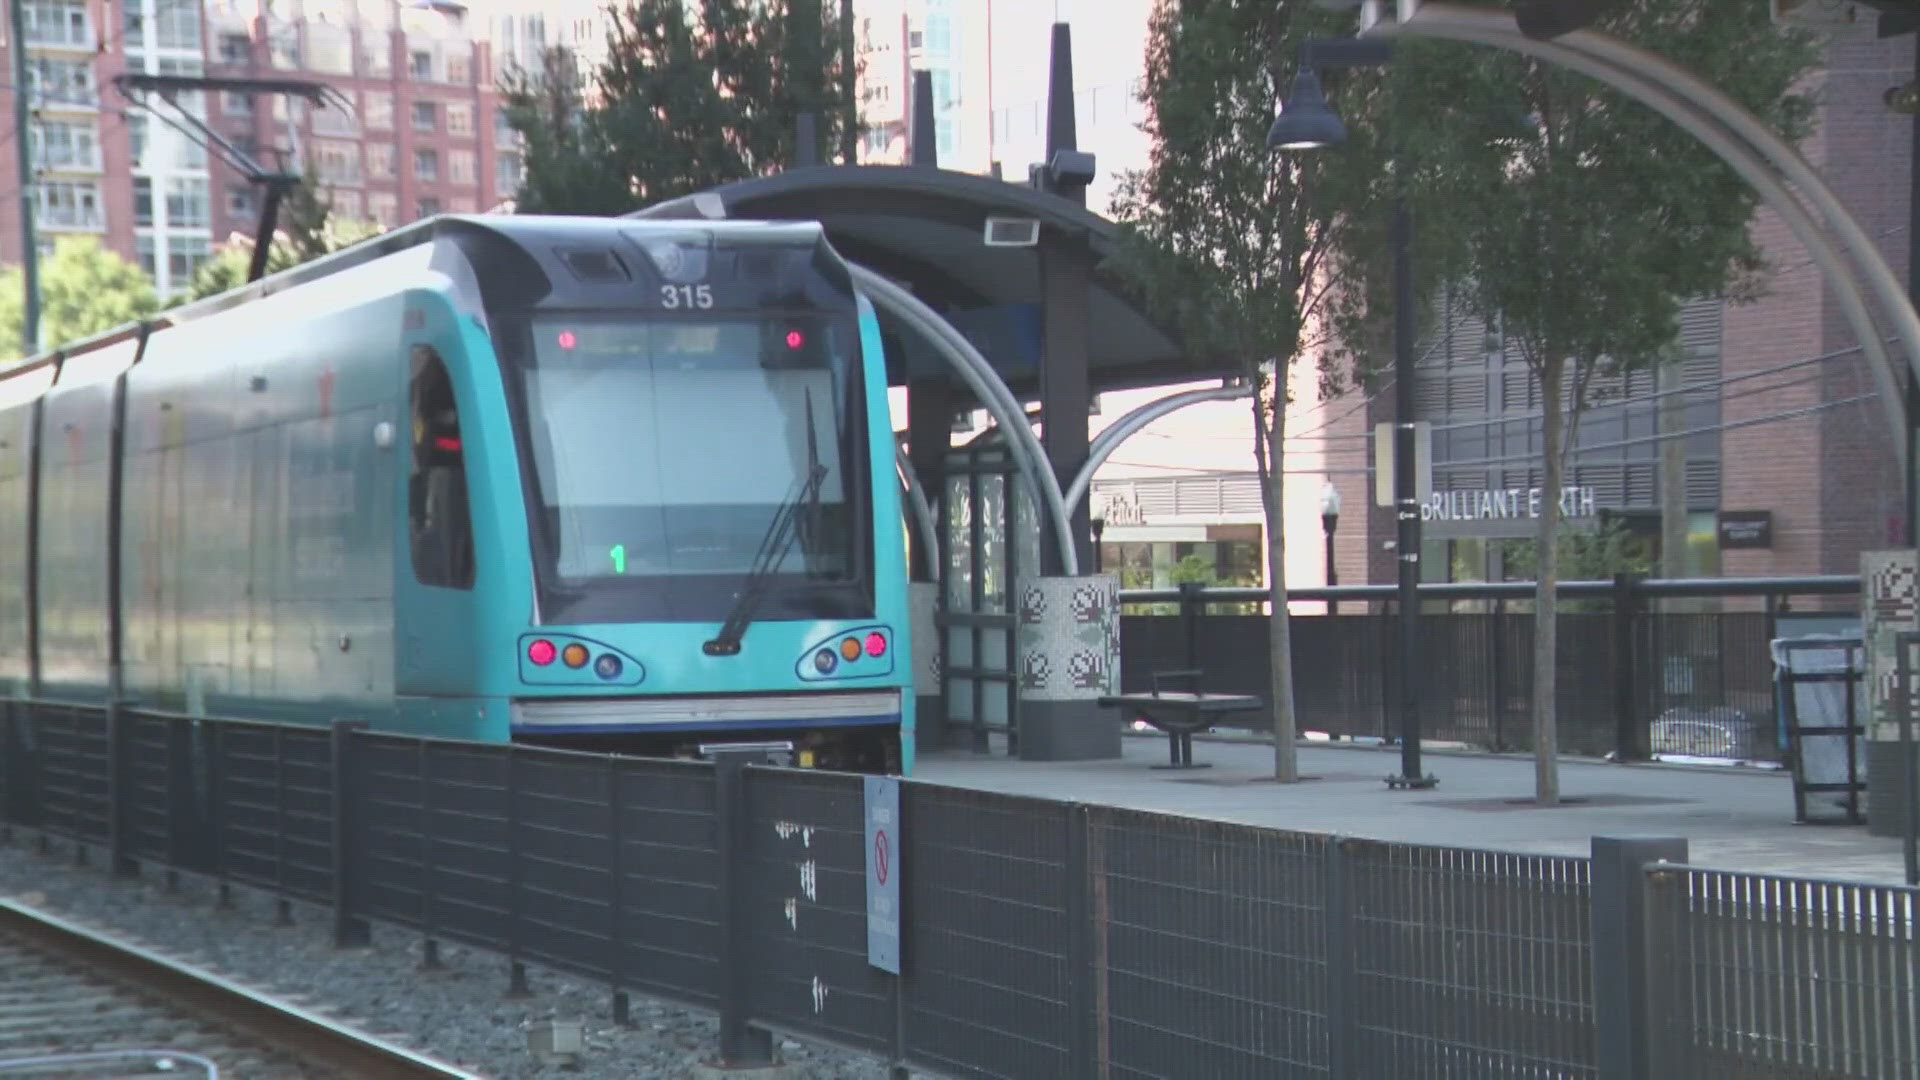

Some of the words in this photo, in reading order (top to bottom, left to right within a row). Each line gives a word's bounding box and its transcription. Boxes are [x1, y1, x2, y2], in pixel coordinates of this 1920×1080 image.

[661, 285, 713, 309] 315
[1528, 487, 1595, 519] ERTH
[609, 544, 625, 573] 1
